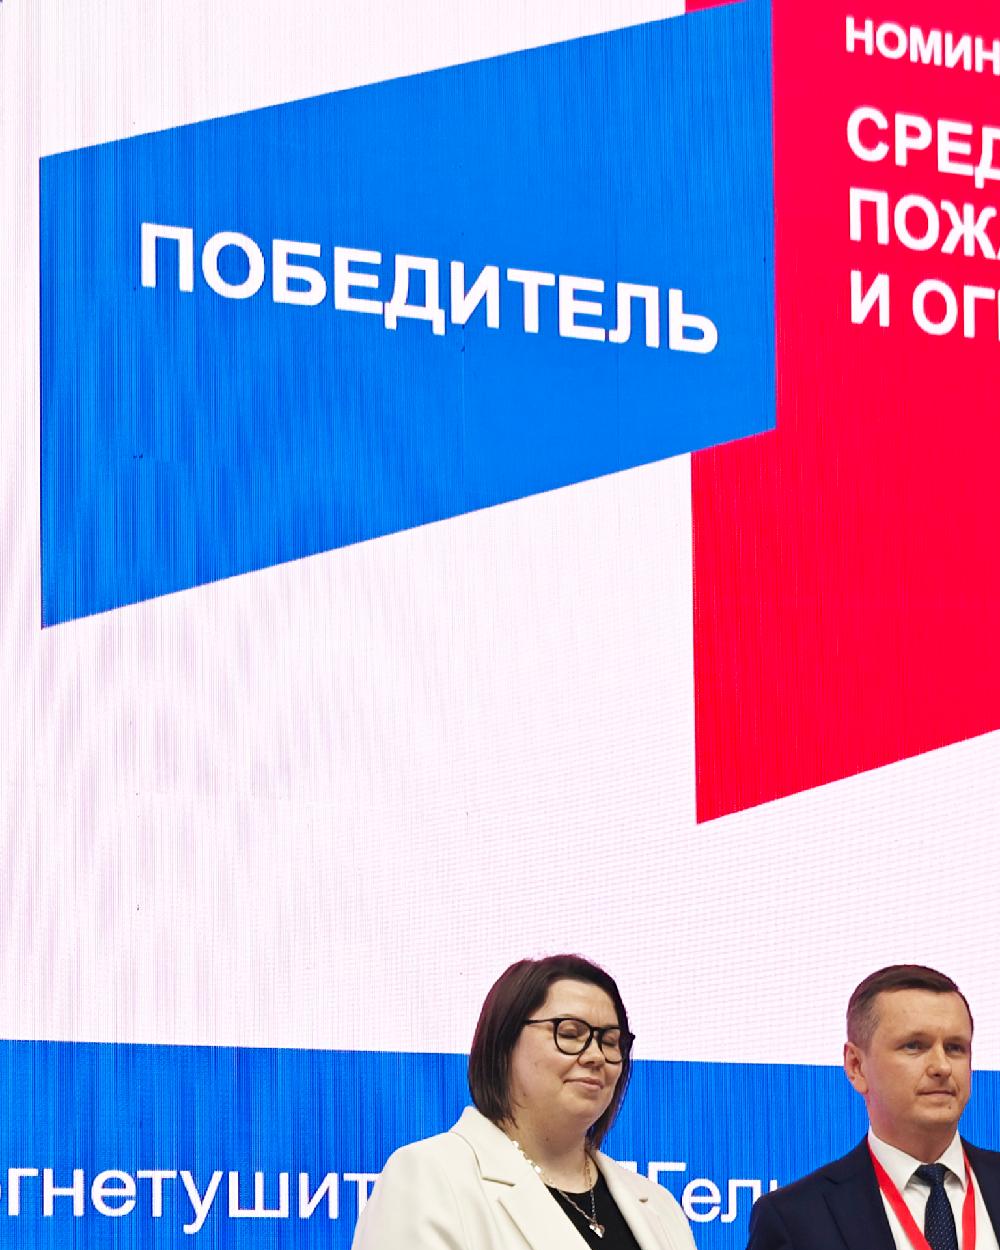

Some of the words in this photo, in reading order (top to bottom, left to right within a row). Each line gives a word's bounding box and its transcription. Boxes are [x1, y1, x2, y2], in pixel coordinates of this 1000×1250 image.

[140, 222, 719, 354] ПОБЕДИТЕЛЬ
[850, 270, 890, 325] И
[0, 1168, 386, 1235] гнетушит
